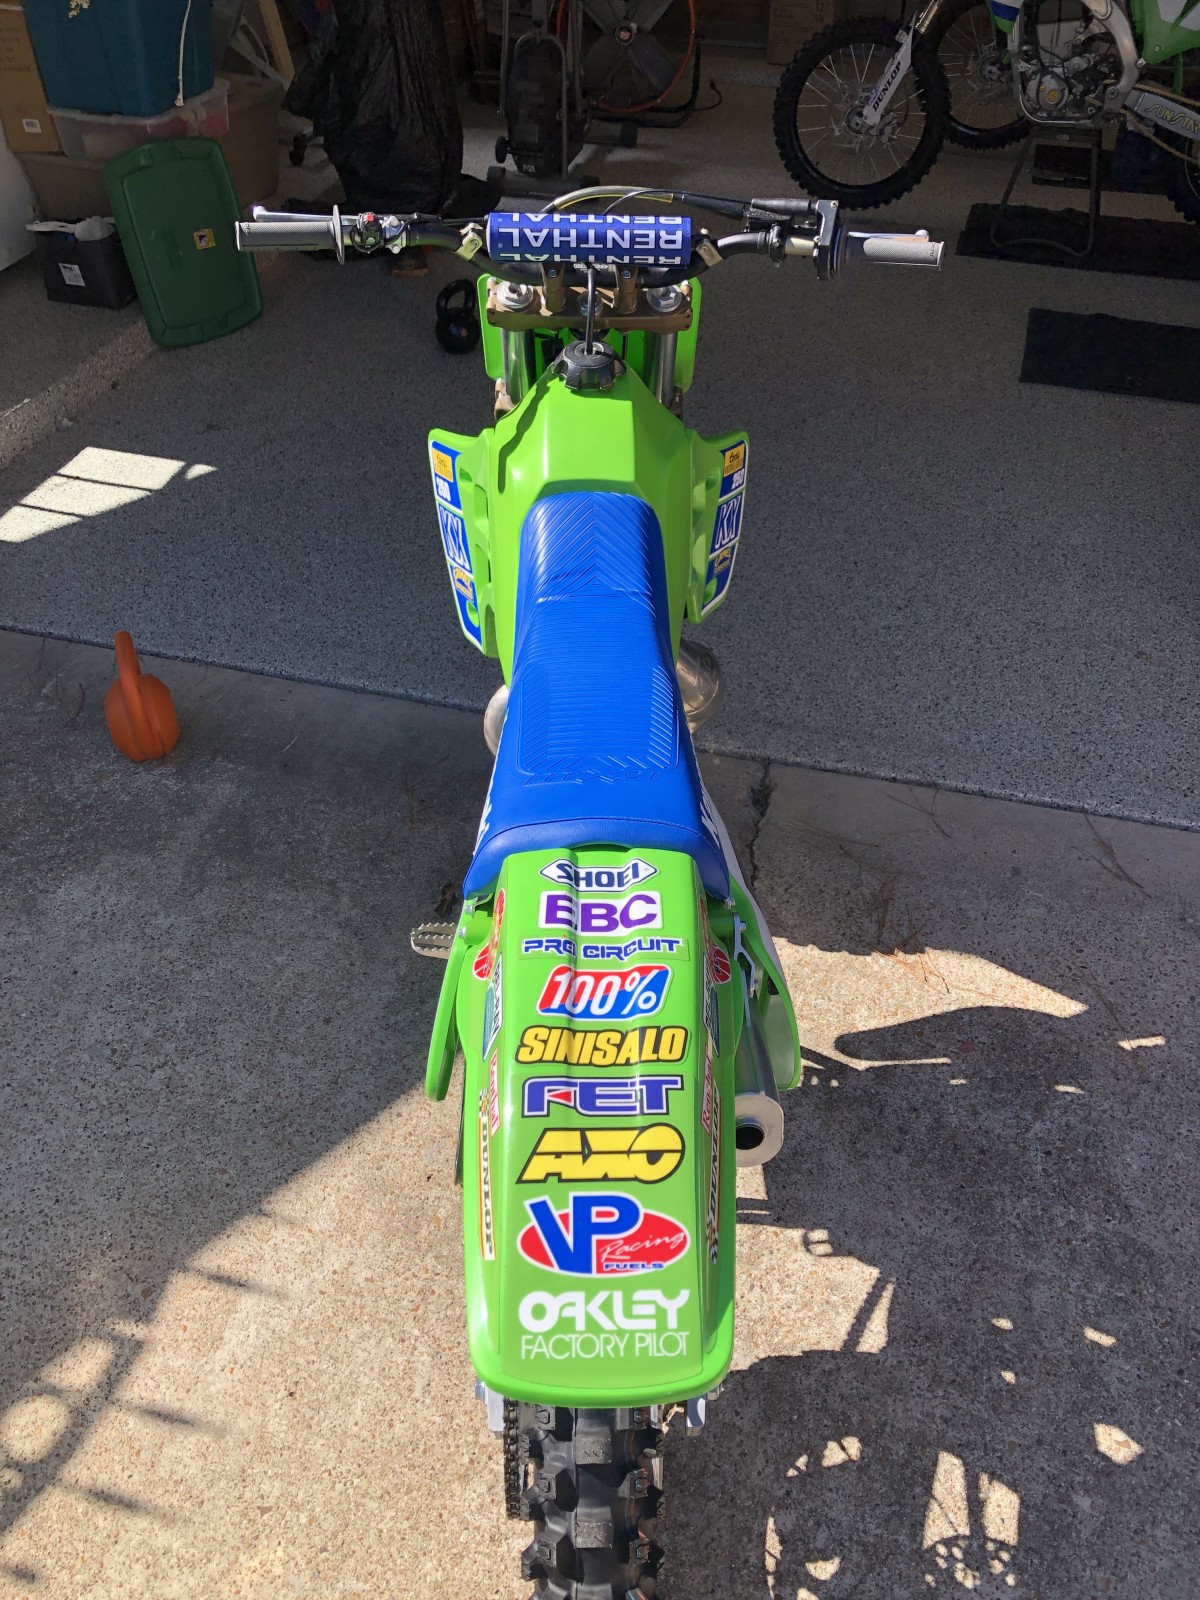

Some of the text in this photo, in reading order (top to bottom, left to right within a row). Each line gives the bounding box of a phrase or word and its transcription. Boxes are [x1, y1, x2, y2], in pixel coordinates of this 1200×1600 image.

[873, 61, 901, 112] DUNLOP
[499, 227, 683, 250] RENTHAL
[556, 862, 640, 888] SHOEI
[544, 893, 658, 933] EBC
[523, 937, 681, 961] PRO CIRCUIT
[551, 968, 661, 1017] 100%
[516, 1026, 689, 1067] SINISALO
[482, 1123, 494, 1256] DUNLOP
[525, 1192, 643, 1275] VP
[600, 1231, 686, 1263] Racing
[603, 1261, 665, 1270] FUELS
[518, 1289, 691, 1333] OAKLEY
[520, 1331, 690, 1360] FACTORY PILOT
